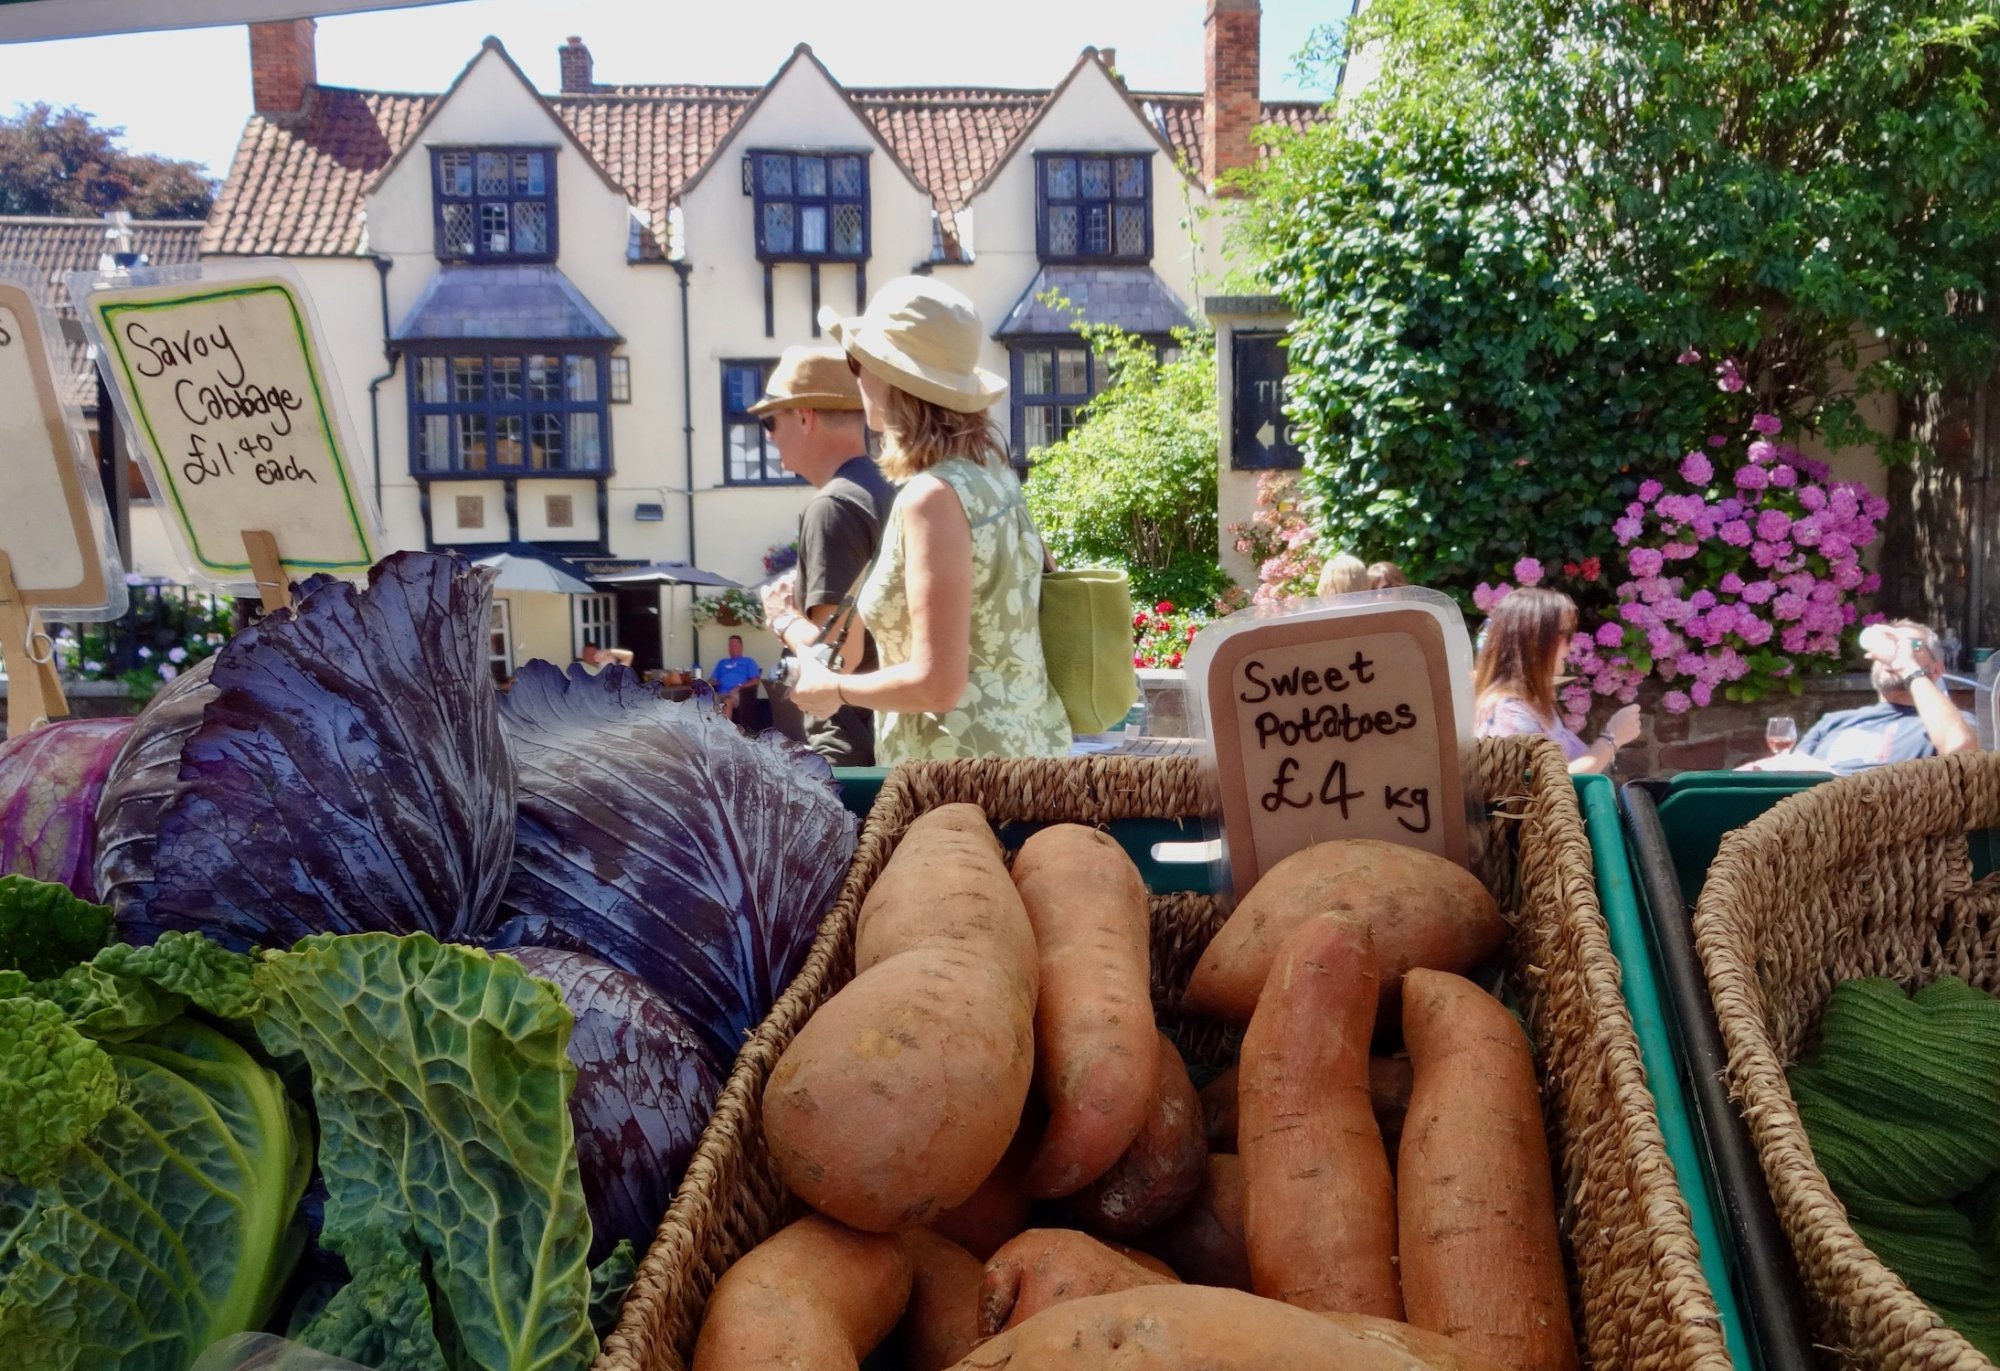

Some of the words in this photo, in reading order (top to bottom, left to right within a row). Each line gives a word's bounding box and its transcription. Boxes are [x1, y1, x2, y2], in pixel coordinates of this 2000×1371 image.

[126, 323, 245, 388] Savoy
[174, 379, 303, 436] Cabbage
[183, 433, 273, 485] £1.40
[255, 455, 317, 485] each
[1240, 651, 1375, 704] Sweet
[1254, 703, 1417, 750] Potatoes
